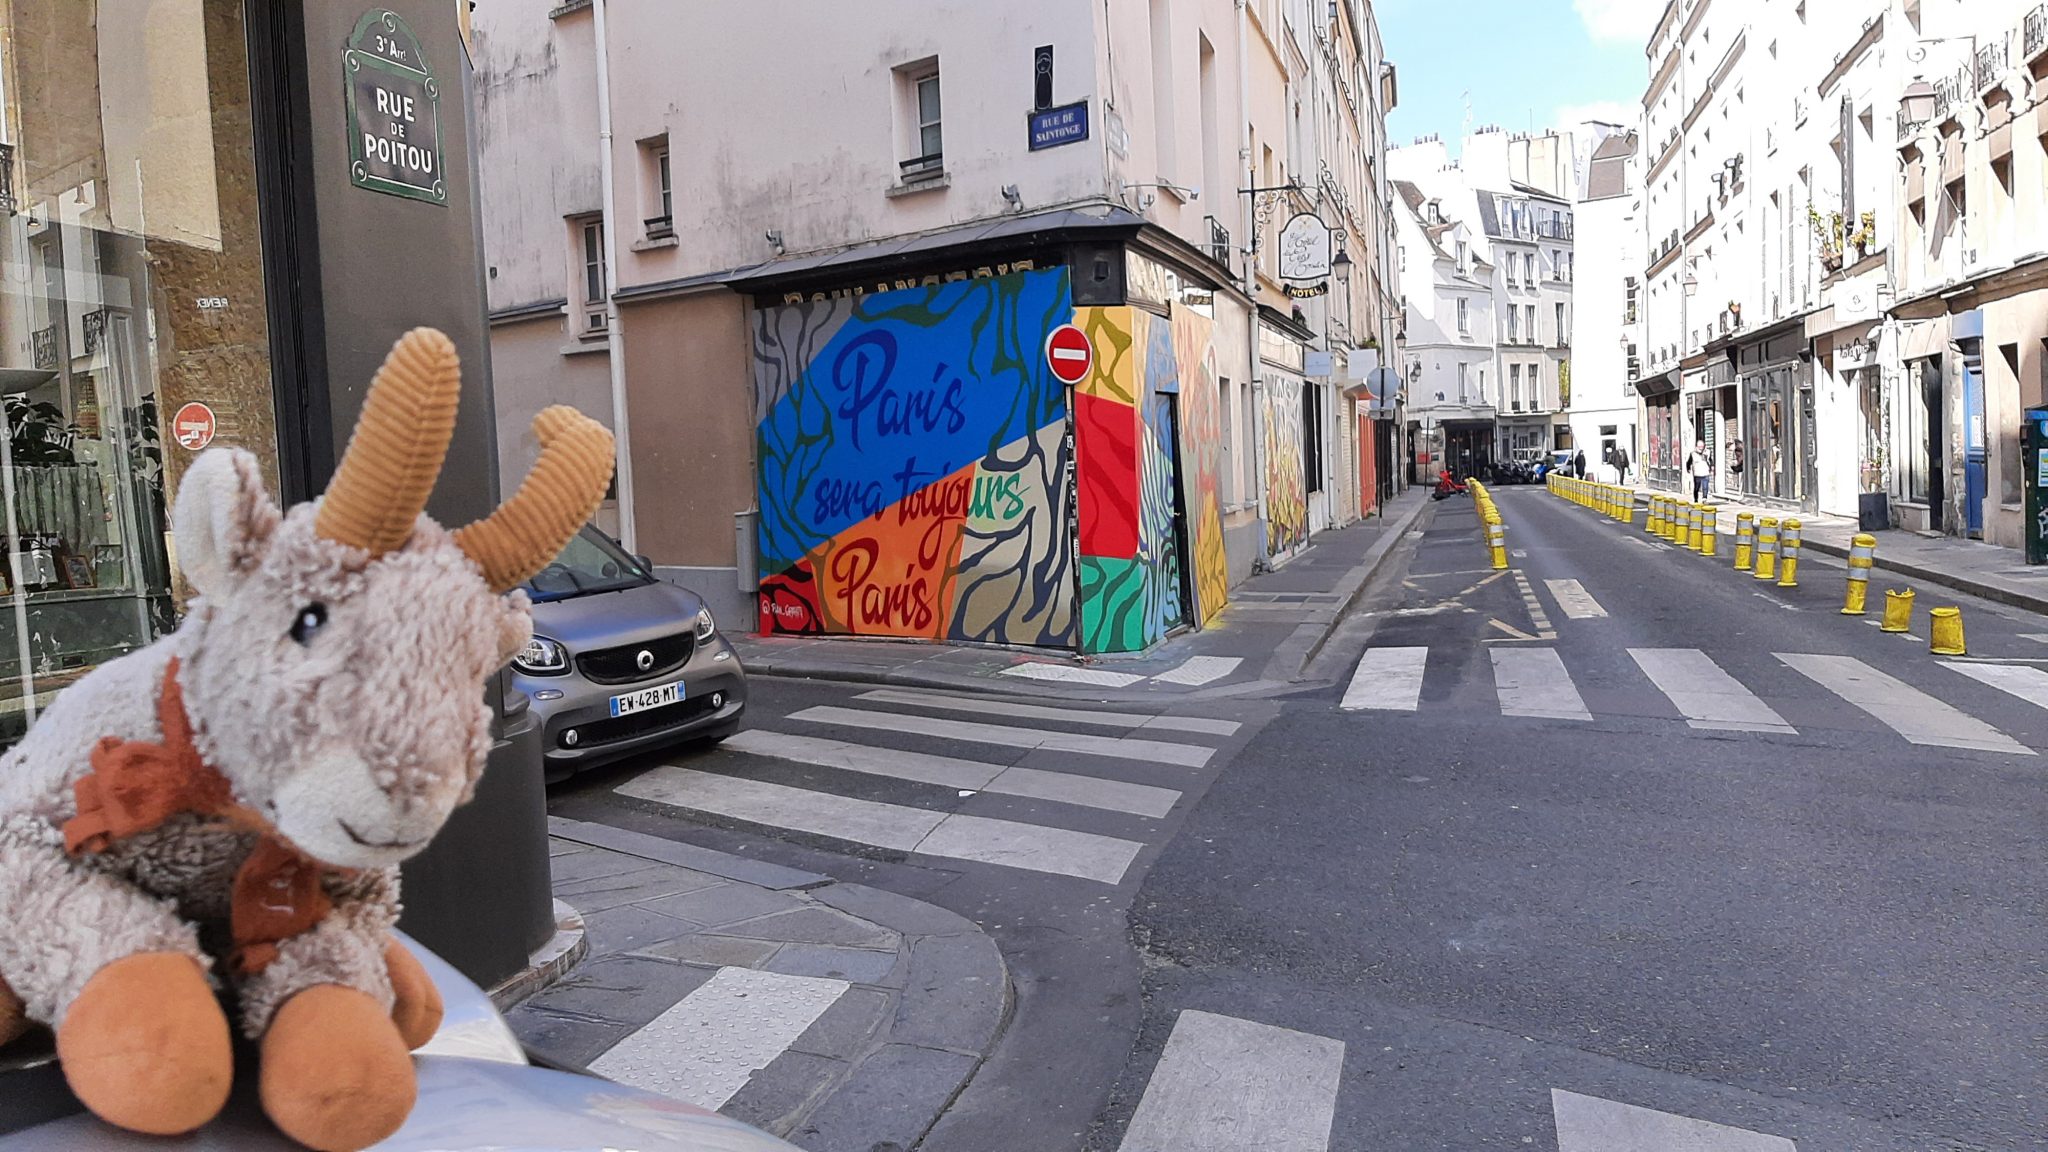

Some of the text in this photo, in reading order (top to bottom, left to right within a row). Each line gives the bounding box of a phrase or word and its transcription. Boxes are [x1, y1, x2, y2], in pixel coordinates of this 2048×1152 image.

[376, 87, 415, 122] RUE
[1042, 112, 1074, 129] RUE DE
[390, 122, 405, 138] DE
[1036, 124, 1081, 143] SAINTONGE
[364, 133, 433, 174] POITOU
[1290, 286, 1319, 298] HOTEL
[832, 329, 966, 452] Paris
[813, 455, 1031, 571] sera toujours
[831, 536, 937, 634] Paris
